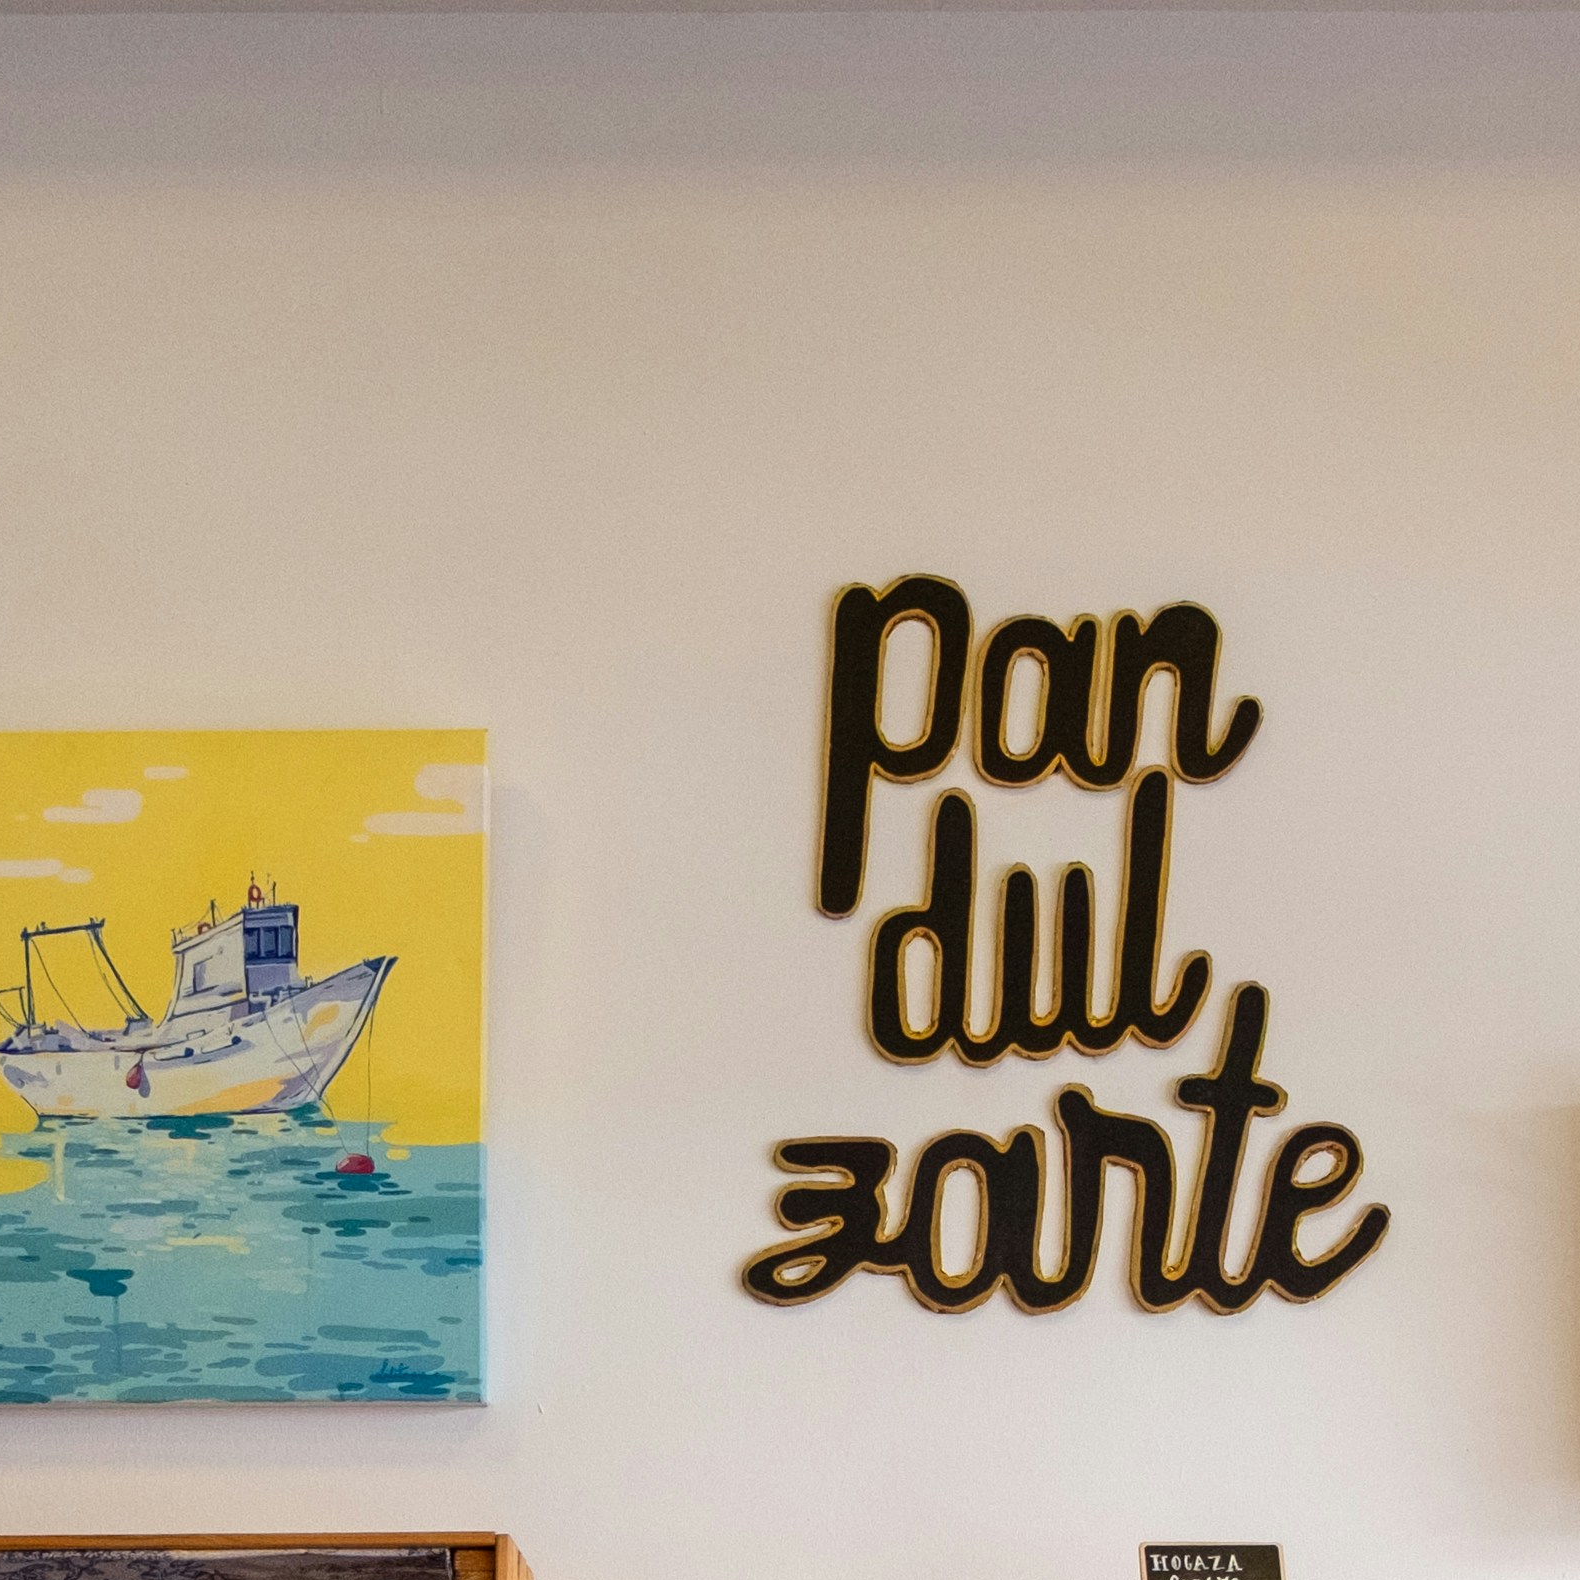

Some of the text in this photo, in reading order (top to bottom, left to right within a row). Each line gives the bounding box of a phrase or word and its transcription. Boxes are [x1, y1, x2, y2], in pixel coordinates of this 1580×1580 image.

[815, 573, 1264, 918] pan
[867, 764, 1212, 1068] dul
[1149, 1553, 1243, 1572] HOGAZA
